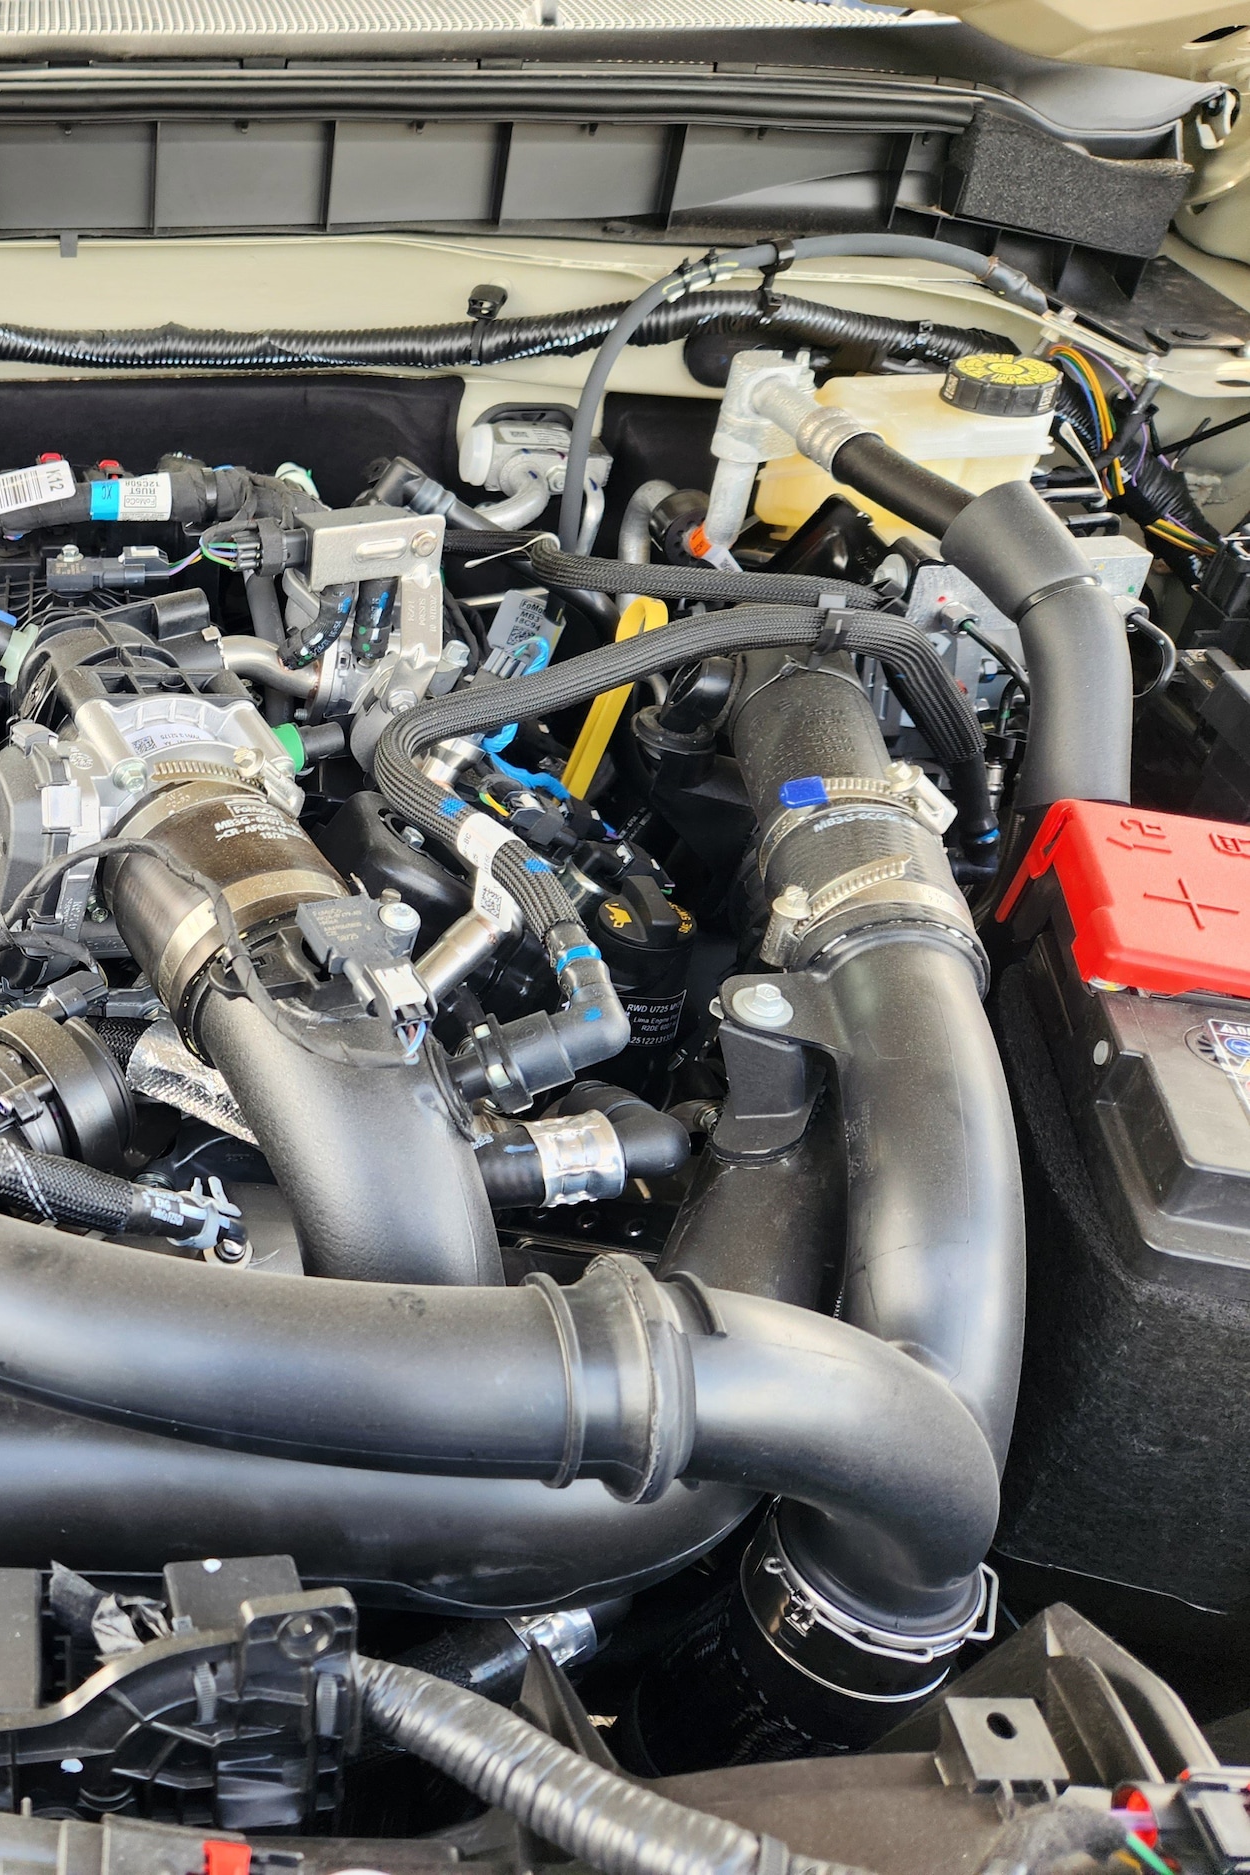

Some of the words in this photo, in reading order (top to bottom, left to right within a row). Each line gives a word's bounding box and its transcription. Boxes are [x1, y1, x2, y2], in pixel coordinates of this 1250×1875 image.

[45, 469, 64, 492] K12
[125, 497, 155, 505] FoMoCo
[521, 601, 546, 614] FoMo
[233, 805, 278, 816] FoMoCo
[627, 1003, 648, 1013] RWD
[649, 1004, 669, 1014] U725
